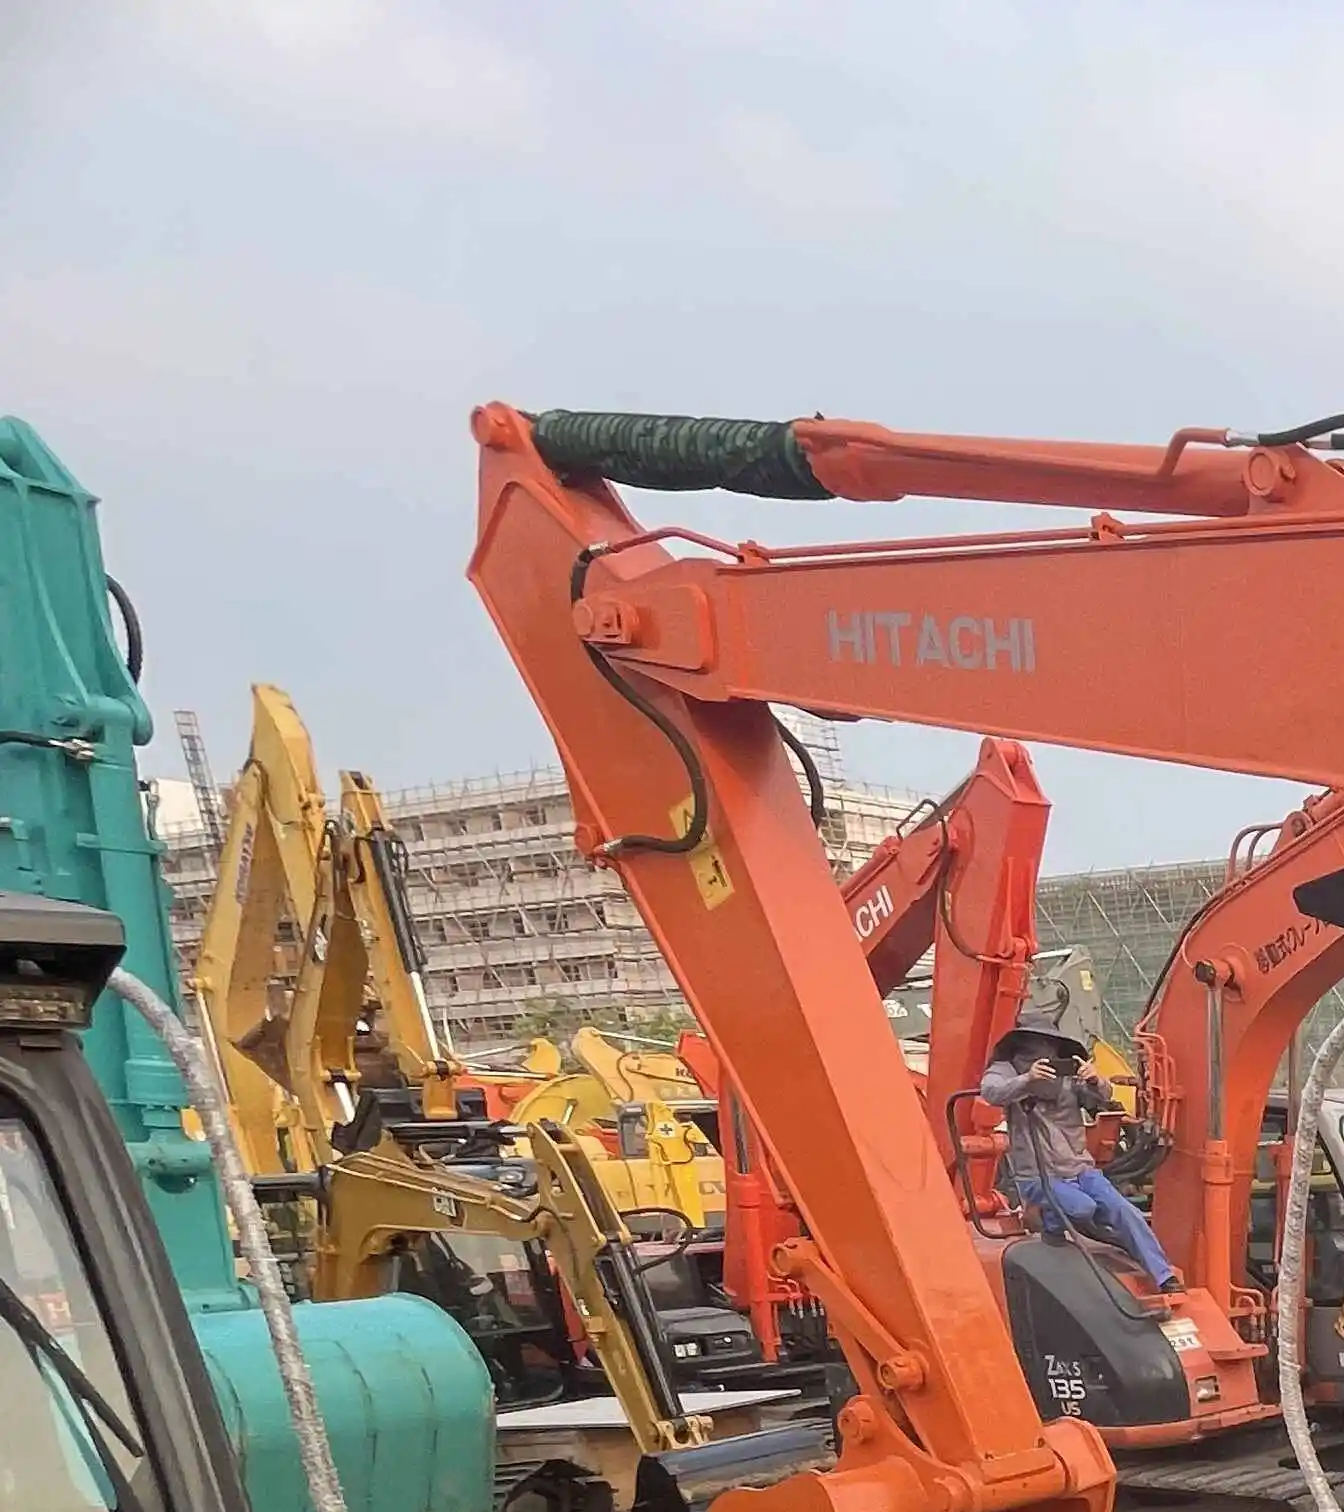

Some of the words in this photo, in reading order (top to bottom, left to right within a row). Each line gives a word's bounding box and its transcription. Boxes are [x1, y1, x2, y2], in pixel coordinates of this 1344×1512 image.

[826, 609, 1036, 674] HITACHI
[853, 884, 894, 942] CHI
[1048, 1378, 1086, 1400] 135
[1060, 1401, 1082, 1416] US
